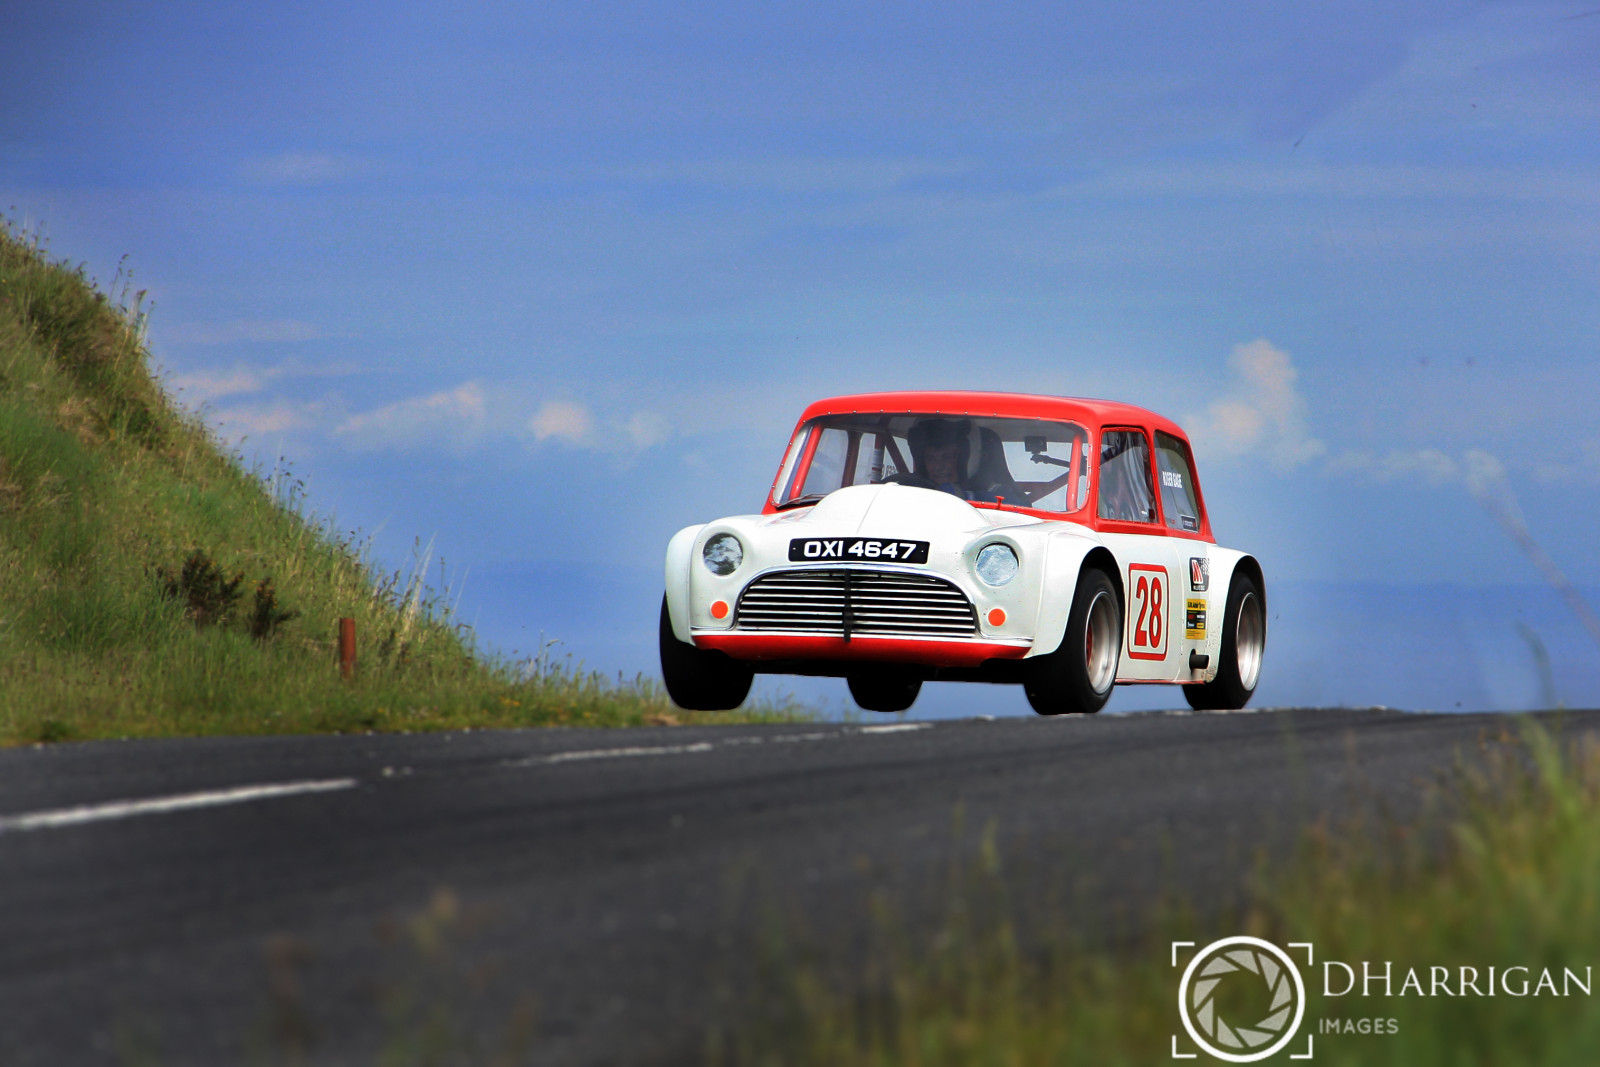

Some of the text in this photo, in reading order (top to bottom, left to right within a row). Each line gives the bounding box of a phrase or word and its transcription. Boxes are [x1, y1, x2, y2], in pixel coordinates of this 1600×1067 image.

[804, 540, 917, 559] OXI 4647
[1134, 575, 1162, 648] 28
